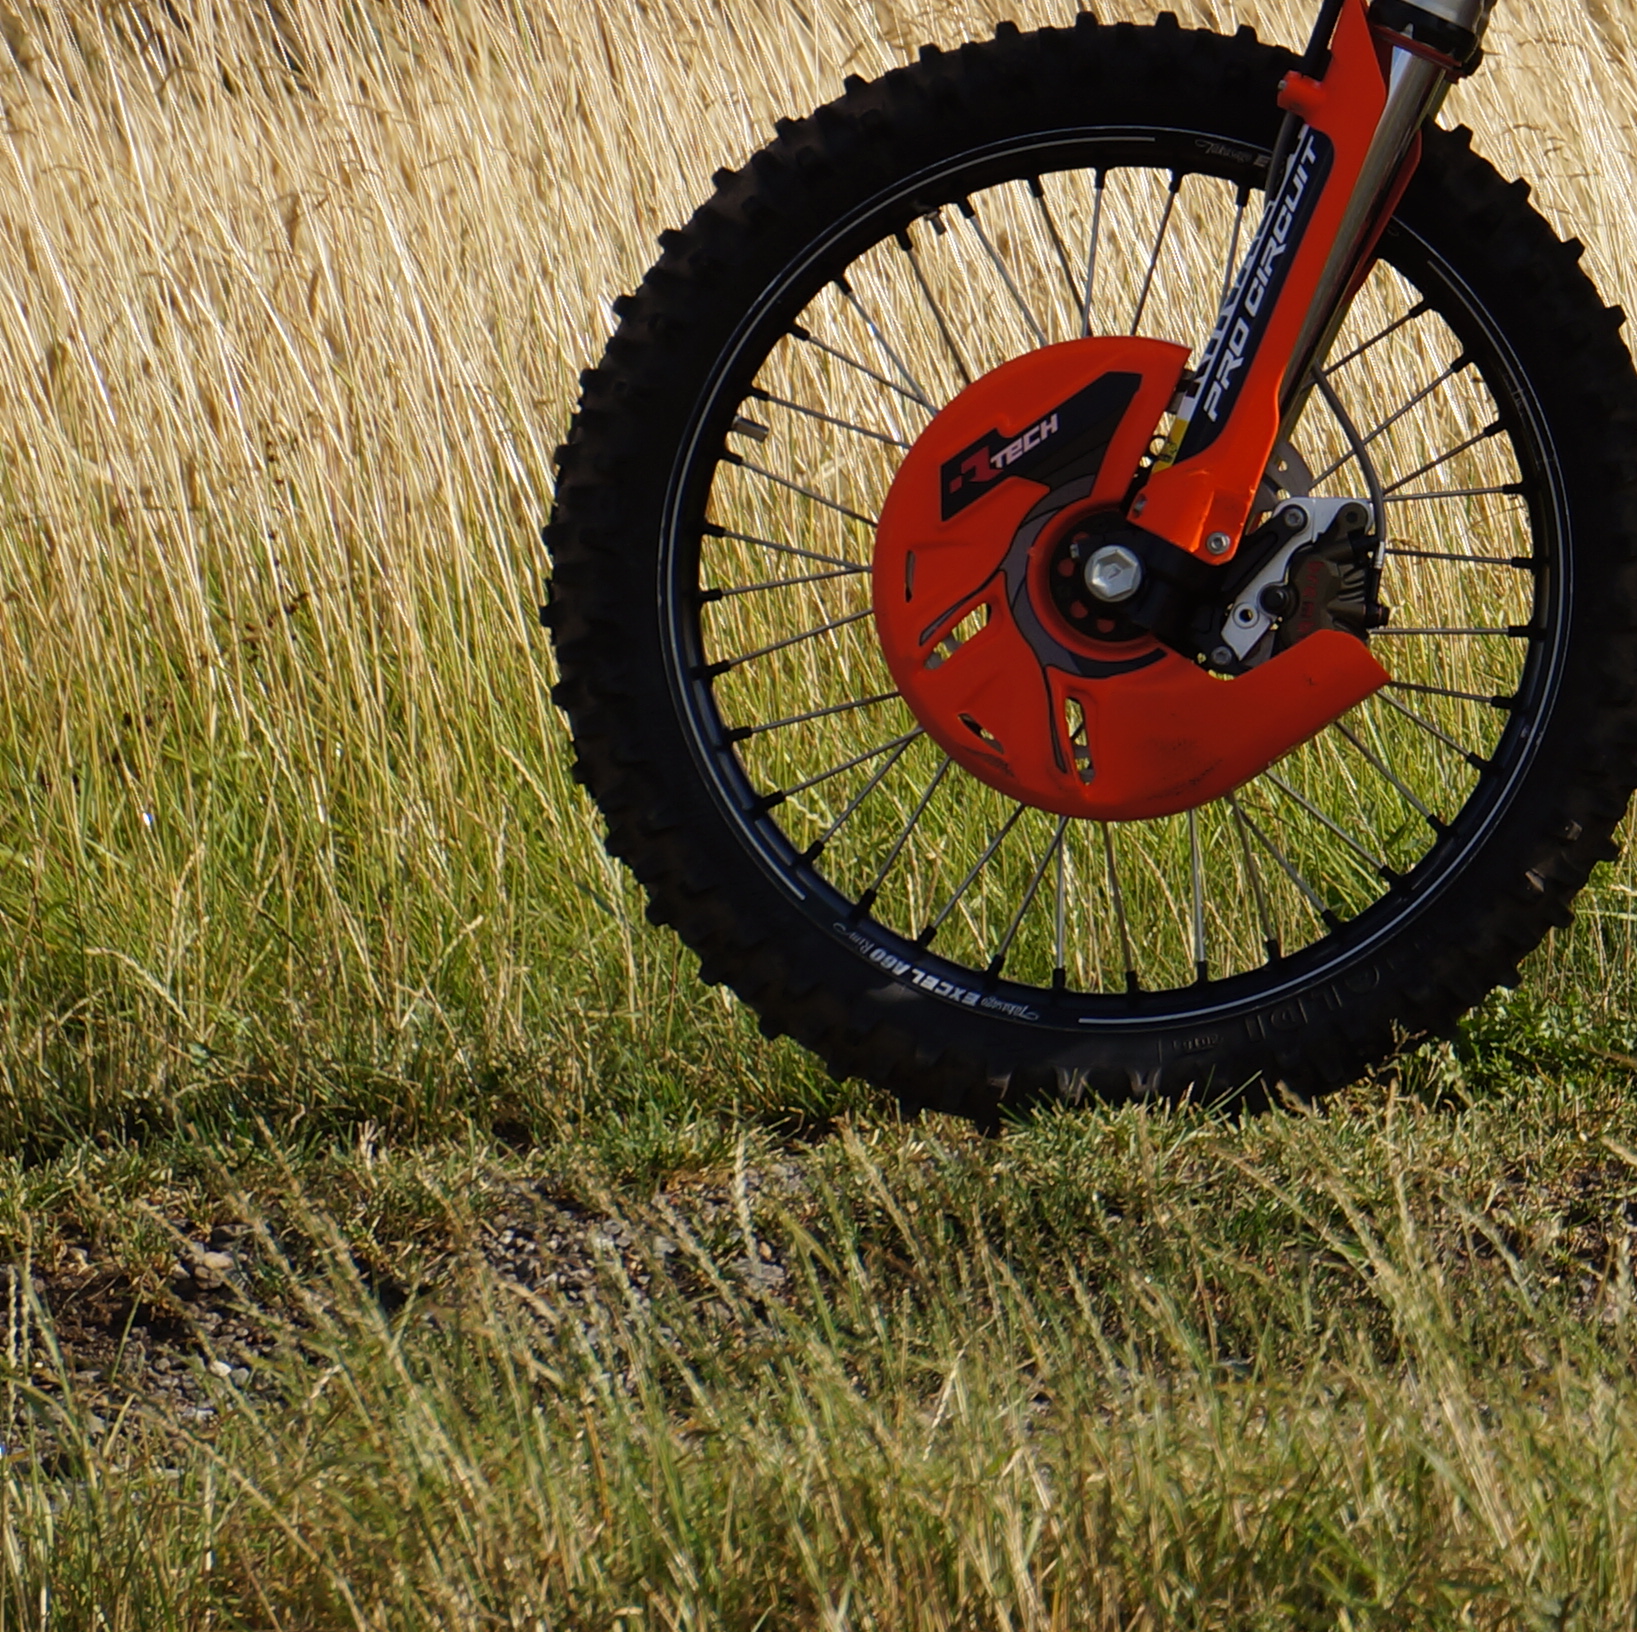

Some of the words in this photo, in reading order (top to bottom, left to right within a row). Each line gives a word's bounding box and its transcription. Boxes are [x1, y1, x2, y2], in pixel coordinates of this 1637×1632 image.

[1204, 317, 1249, 422] PRO
[1244, 136, 1317, 319] CIRCUIT
[833, 923, 874, 955] Rim
[908, 967, 981, 1007] EXCEL
